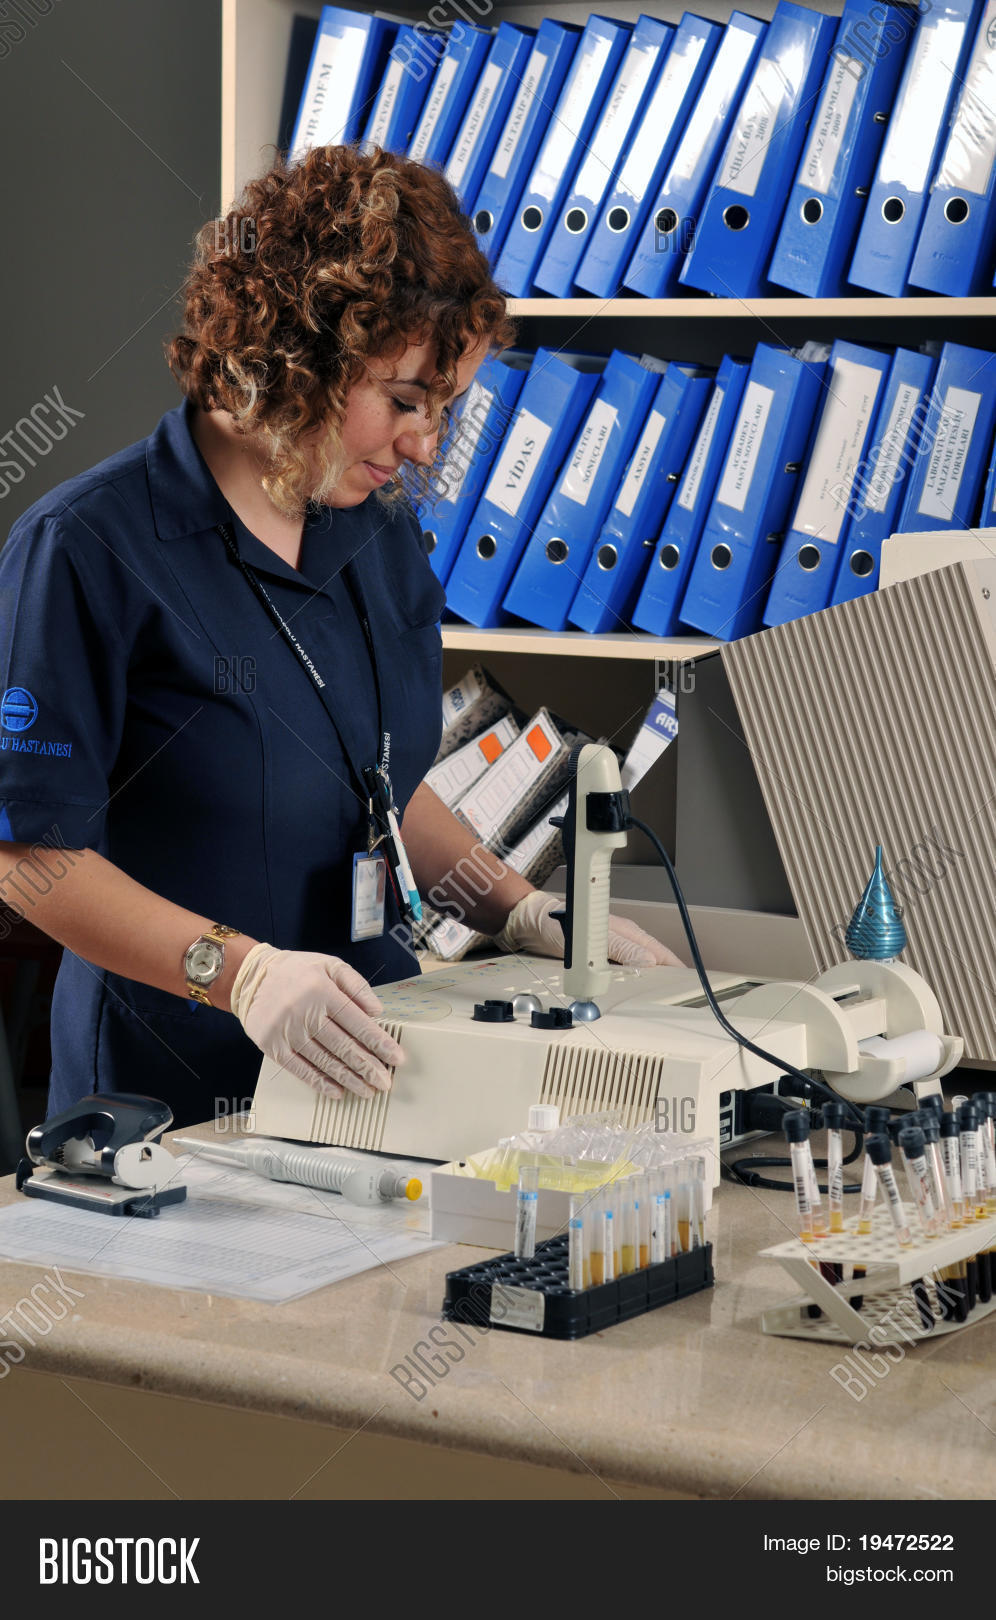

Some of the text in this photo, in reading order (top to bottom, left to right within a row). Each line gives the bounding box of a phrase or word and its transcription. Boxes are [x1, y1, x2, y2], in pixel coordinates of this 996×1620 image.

[511, 99, 528, 134] TAKİP
[756, 115, 770, 141] 2008
[830, 112, 843, 137] 2009
[505, 436, 536, 491] VİDAS
[937, 446, 954, 497] MALZEME
[952, 429, 970, 480] FORMLARI
[295, 642, 326, 689] HASTANESİ
[381, 731, 392, 773] STANESİ
